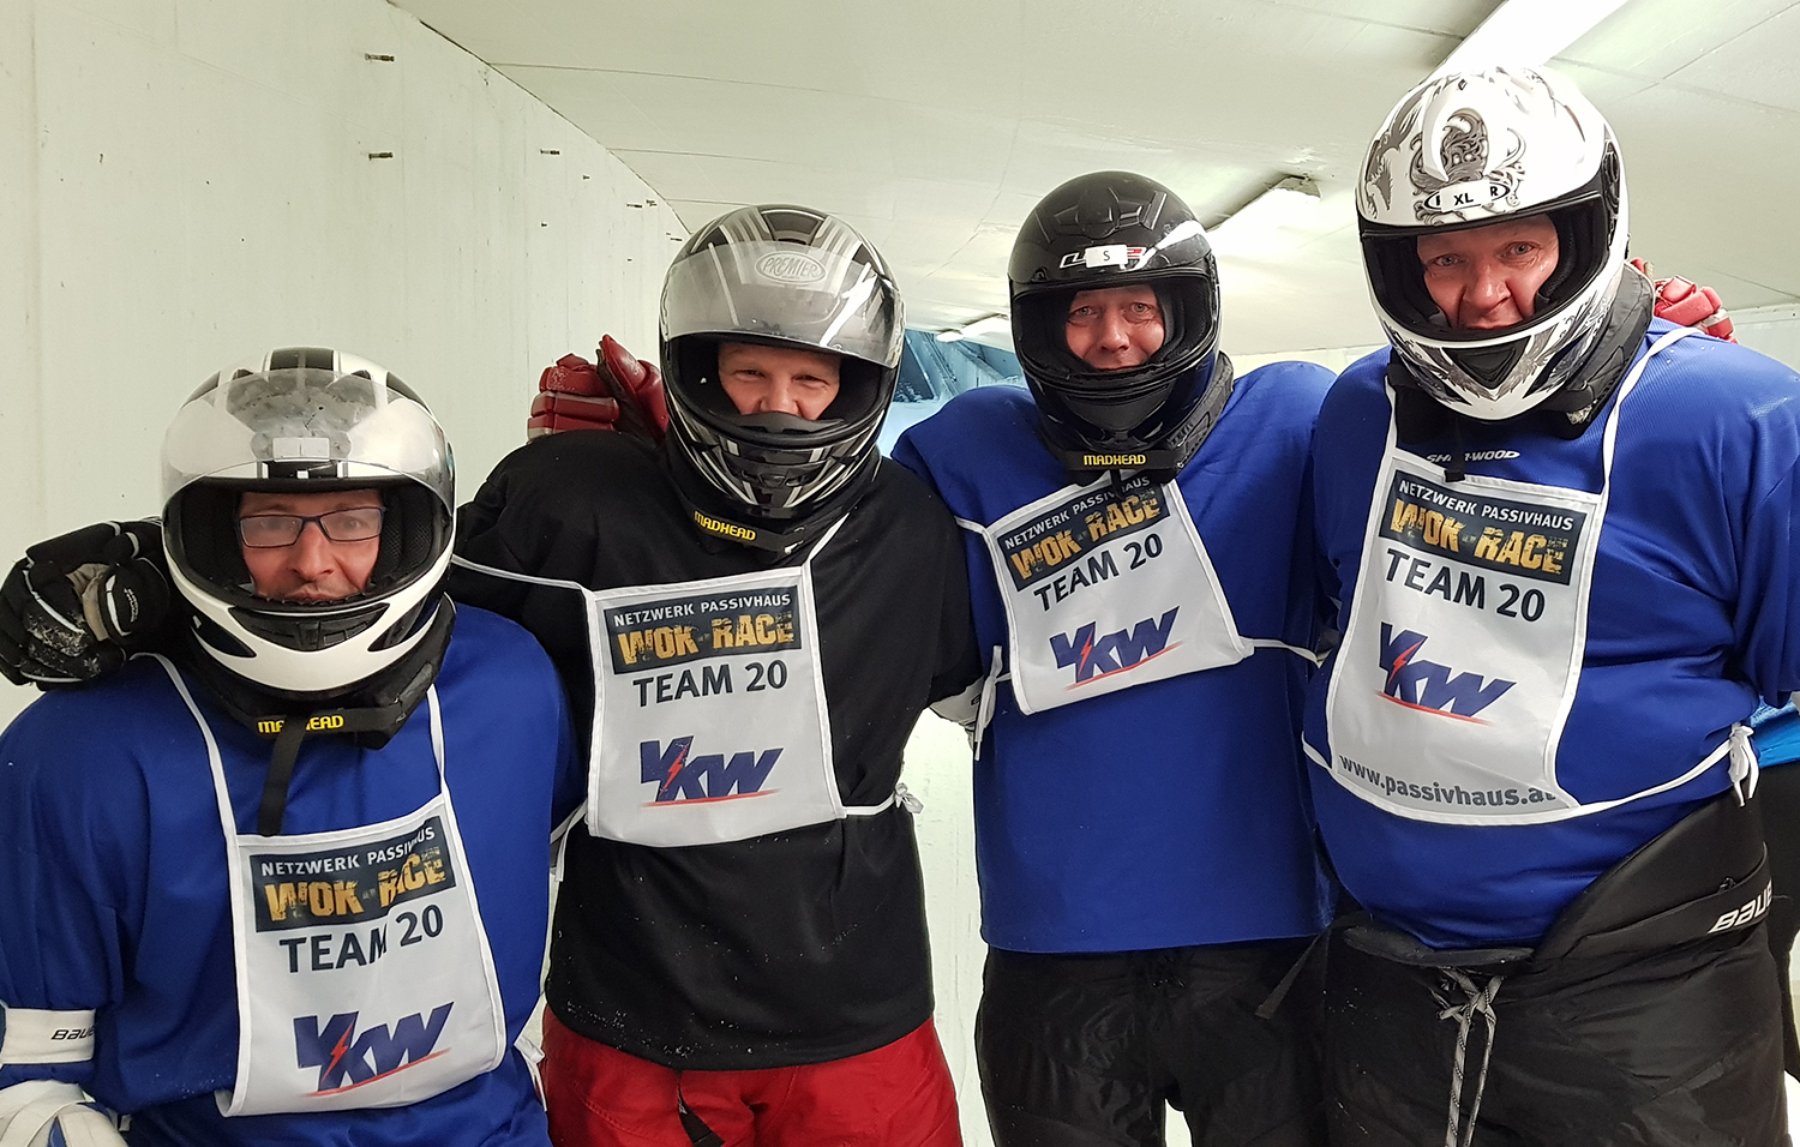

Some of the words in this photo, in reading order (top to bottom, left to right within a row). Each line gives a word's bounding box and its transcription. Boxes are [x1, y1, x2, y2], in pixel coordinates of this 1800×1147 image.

[1454, 193, 1475, 206] XL
[763, 257, 821, 278] PREMIER
[1103, 250, 1111, 262] S
[1084, 454, 1146, 466] MADHEAD
[1426, 450, 1520, 463] SH-WOOD
[694, 510, 756, 541] MADHEAD
[1005, 510, 1070, 550] NETZWERK
[1072, 476, 1150, 516] PASSIVAUS
[1399, 480, 1477, 516] NETZWERK
[1481, 505, 1573, 531] PASSIVHAUS
[1011, 529, 1082, 580] WOK
[1084, 491, 1161, 543] RACE
[1390, 499, 1466, 553] WOK
[1473, 526, 1569, 576] RACE
[1033, 550, 1120, 612] TEAM
[1123, 533, 1163, 571] 20
[1384, 548, 1485, 610] TEAM
[1496, 584, 1545, 622] 20
[614, 604, 694, 627] NETZWERK
[701, 594, 791, 613] PASSIVHAUS
[617, 625, 699, 665] WOK
[711, 612, 795, 649] RACE
[633, 663, 733, 707] TEAM
[745, 659, 788, 692] 20
[257, 715, 344, 733] MAEAD
[261, 855, 360, 876] NETZWERK
[367, 827, 435, 865] PASSIVUS
[264, 880, 364, 921] WOK
[279, 923, 387, 973] TEAM
[396, 904, 443, 947] 20
